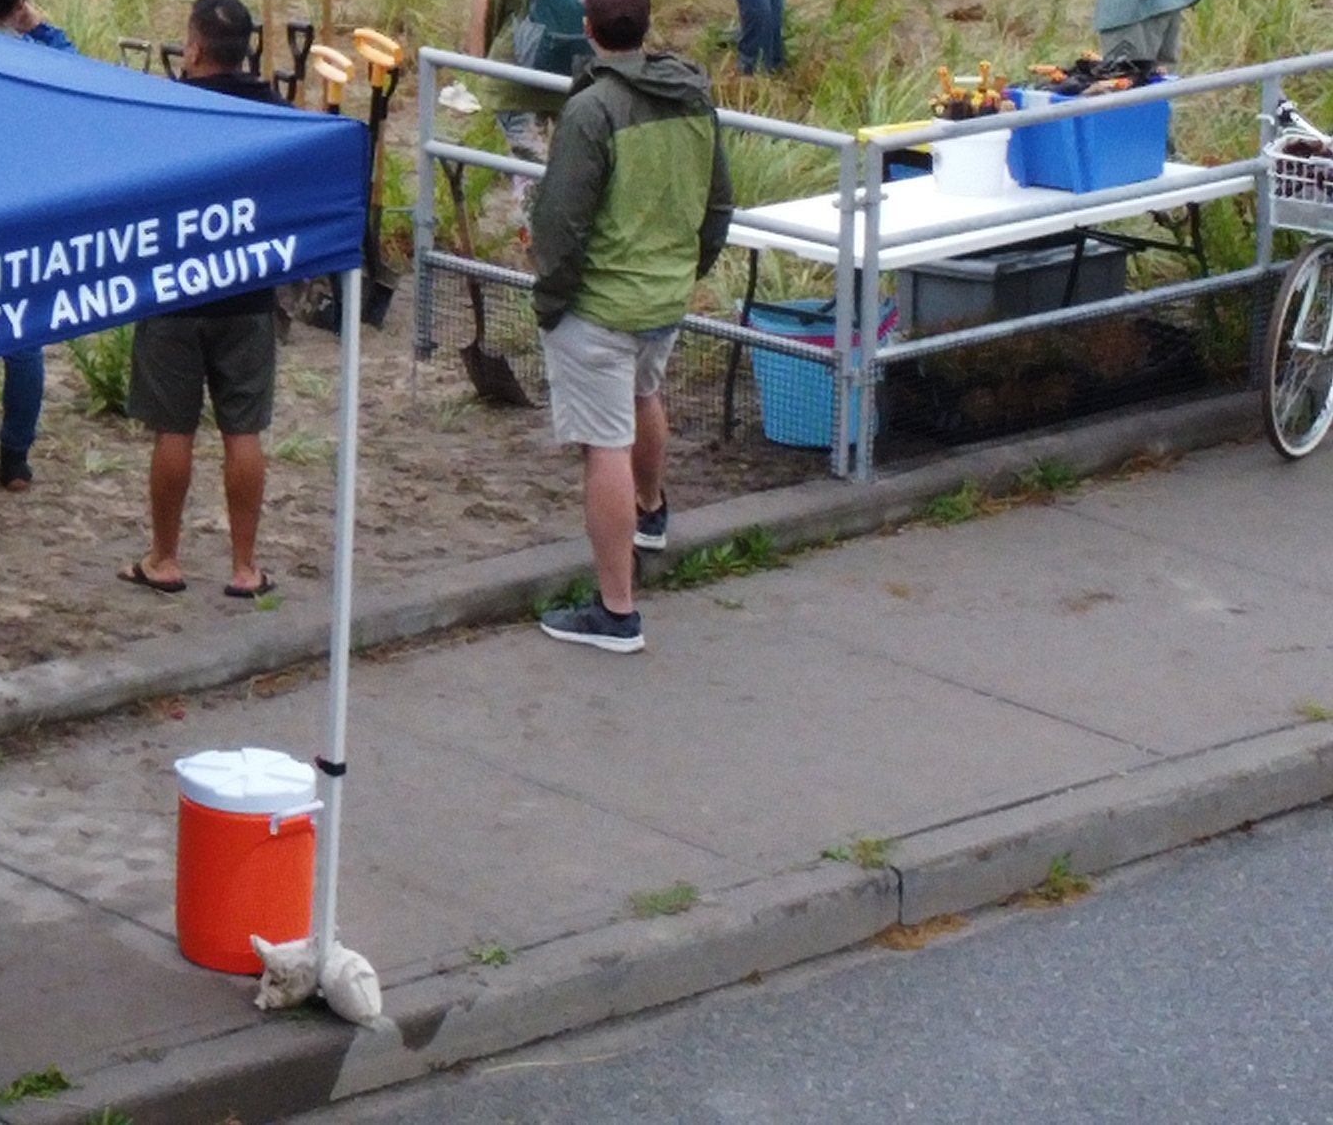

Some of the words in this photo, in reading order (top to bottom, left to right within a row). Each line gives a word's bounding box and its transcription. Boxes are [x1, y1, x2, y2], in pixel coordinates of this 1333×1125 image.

[177, 197, 256, 249] FOR
[50, 275, 135, 329] AND
[151, 235, 297, 304] EQUITY
